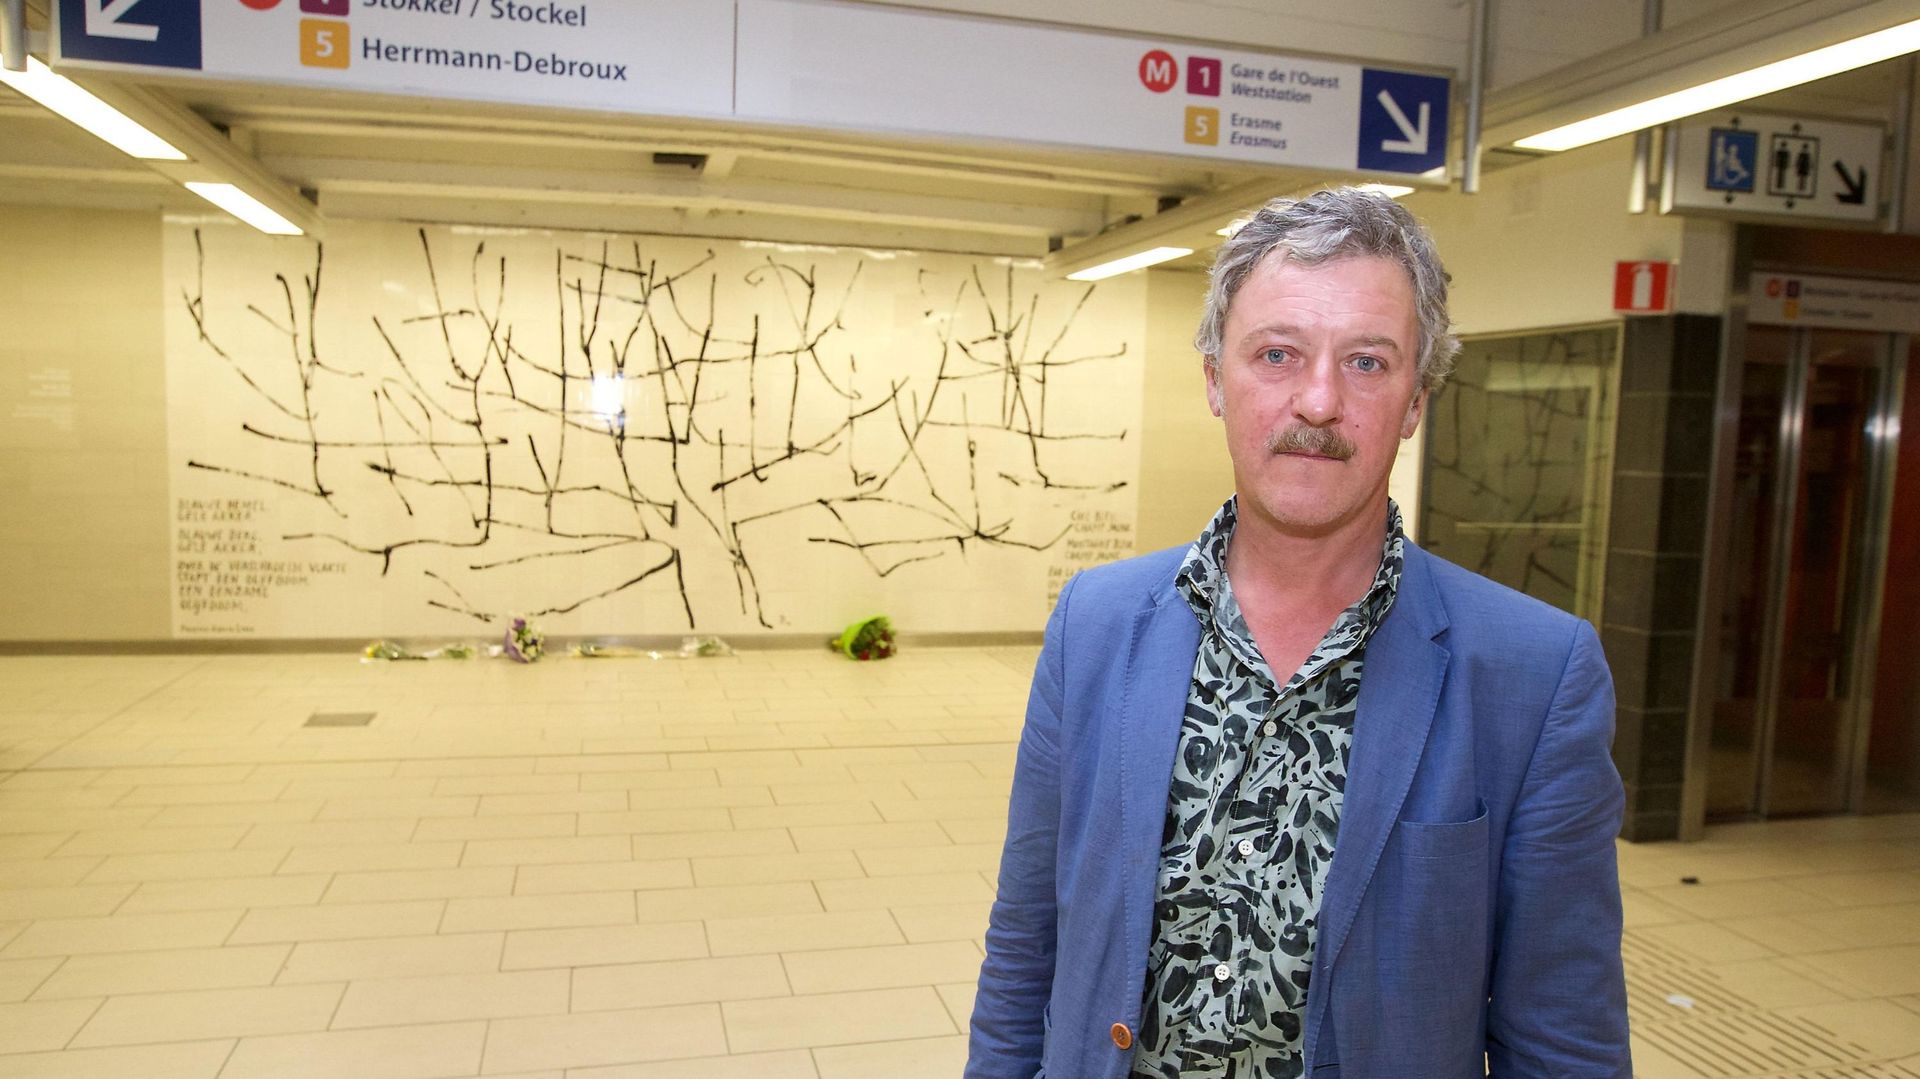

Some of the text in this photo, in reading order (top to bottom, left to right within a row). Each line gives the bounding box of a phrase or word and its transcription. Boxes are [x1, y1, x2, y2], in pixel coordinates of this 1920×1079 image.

[490, 0, 587, 27] Stockel
[315, 30, 334, 58] 5
[362, 37, 627, 81] Herrmann-Debroux
[1146, 59, 1210, 88] M 1
[1230, 63, 1340, 89] Gare de l'Ouest
[1230, 82, 1312, 104] Weststation
[1195, 116, 1208, 137] 5
[1230, 112, 1283, 131] Erasme
[1230, 131, 1288, 150] Erasmus
